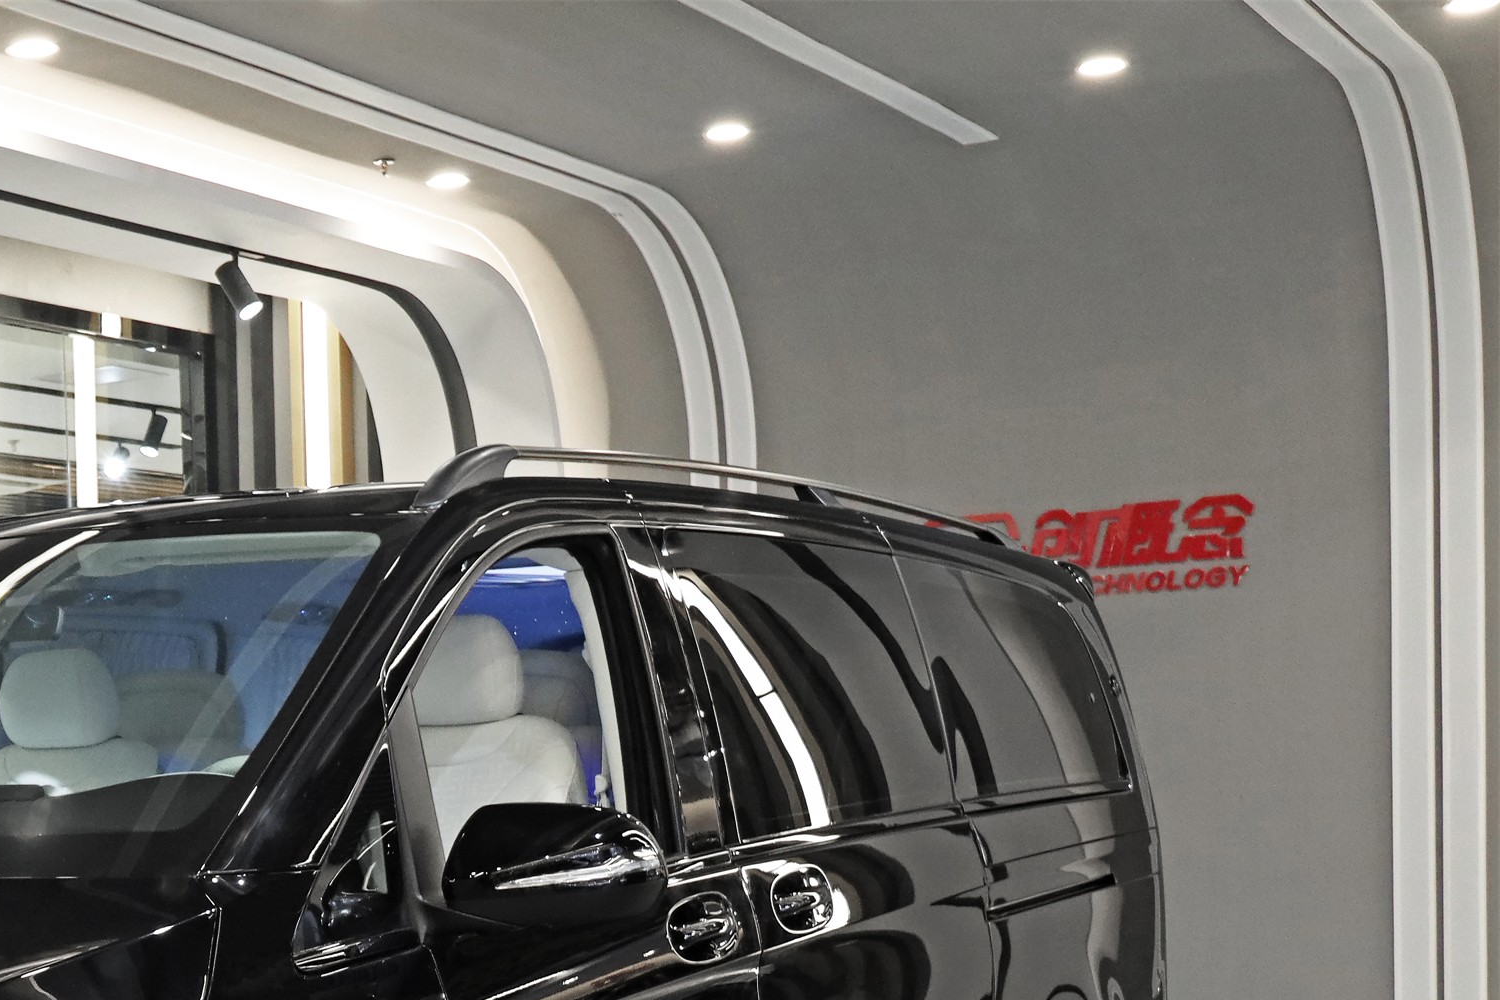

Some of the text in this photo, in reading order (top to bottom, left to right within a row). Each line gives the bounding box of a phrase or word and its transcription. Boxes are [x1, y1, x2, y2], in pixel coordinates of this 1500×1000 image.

[1028, 493, 1255, 568] 创概念
[1092, 564, 1249, 596] CHNOLOGY
